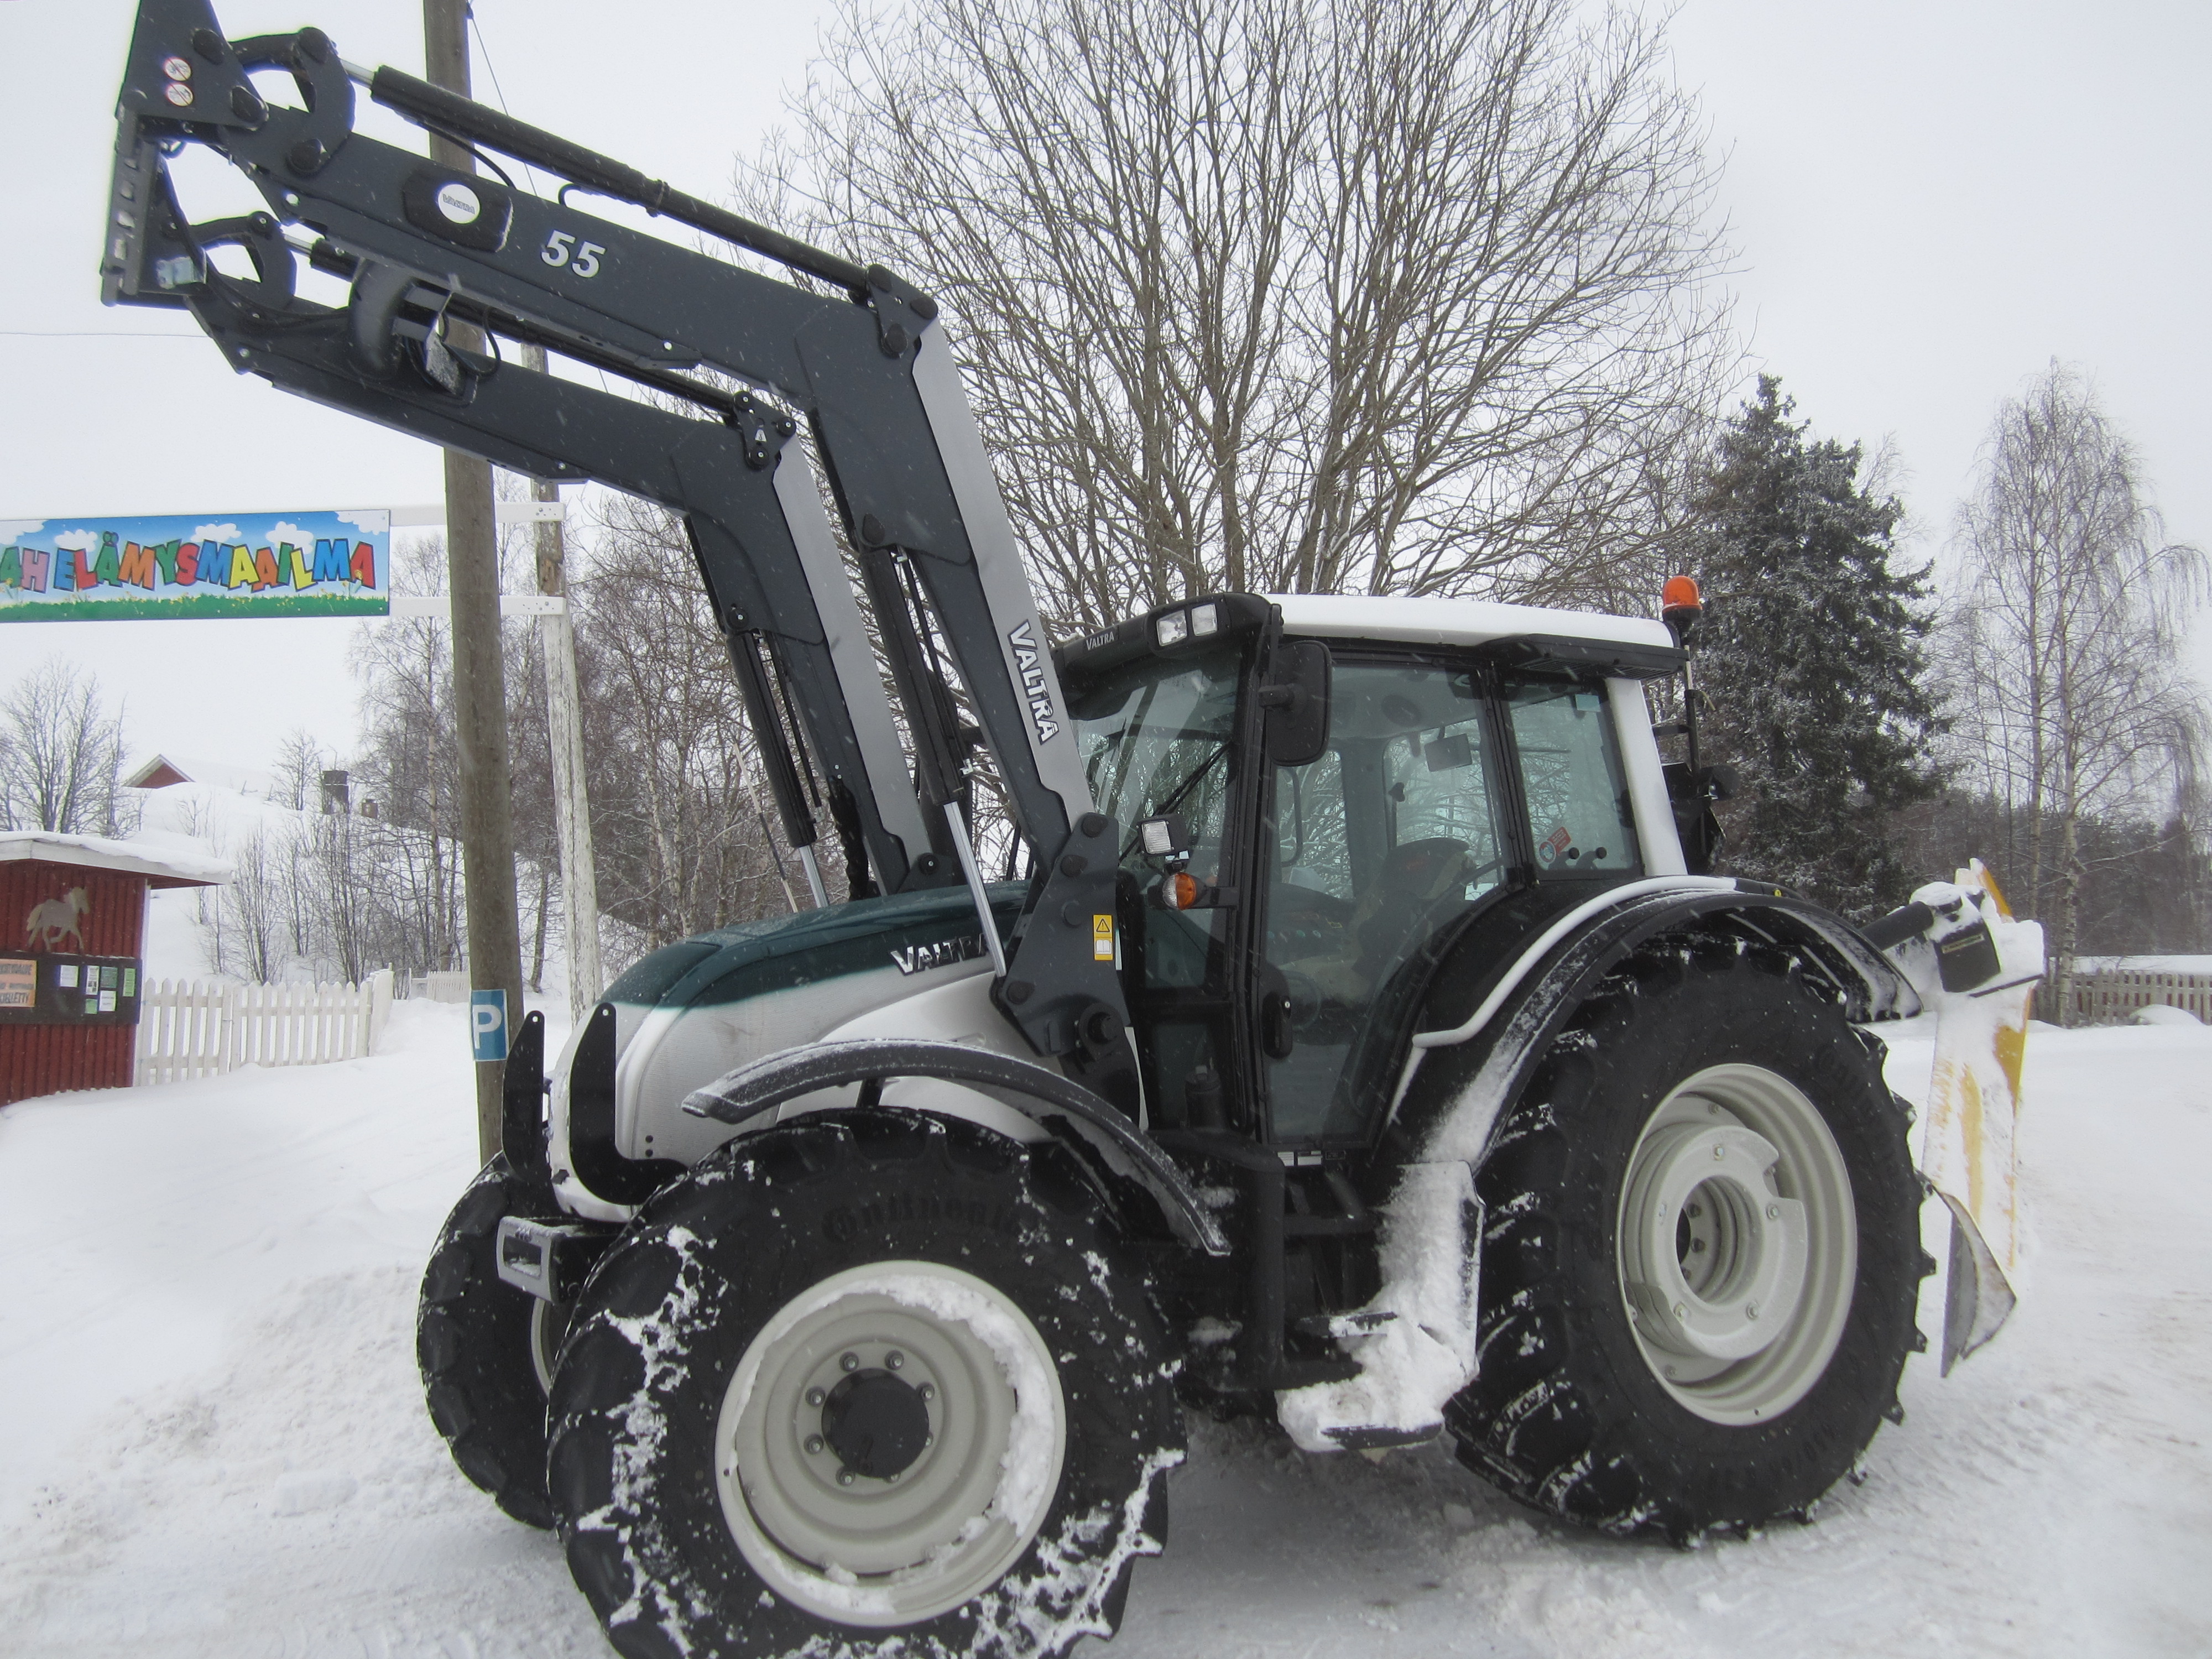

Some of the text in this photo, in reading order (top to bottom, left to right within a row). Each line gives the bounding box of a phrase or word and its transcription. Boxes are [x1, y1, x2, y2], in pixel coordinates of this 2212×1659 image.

[442, 195, 475, 213] VALTRA
[541, 229, 606, 278] 55
[54, 531, 376, 593] ELÄMYSMAAILMA
[1086, 631, 1115, 651] VALTRA
[1008, 619, 1060, 745] VALTRA
[472, 1004, 502, 1050] P
